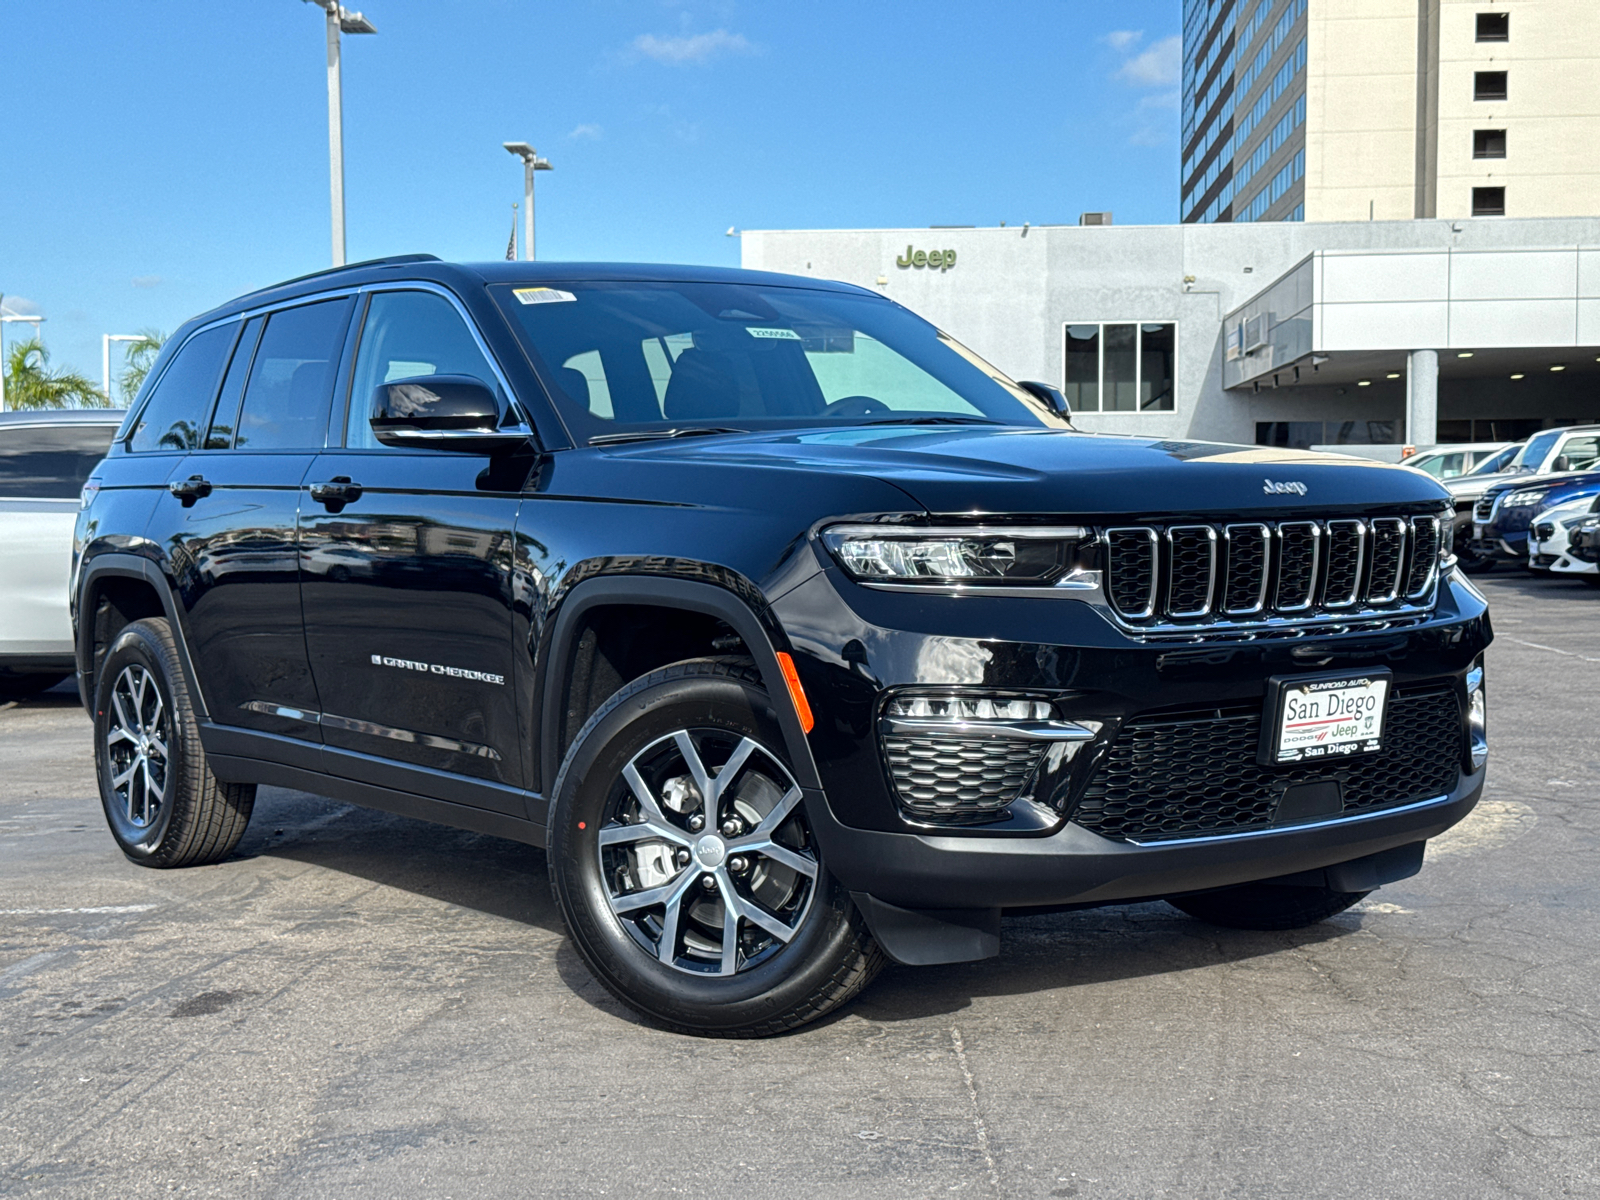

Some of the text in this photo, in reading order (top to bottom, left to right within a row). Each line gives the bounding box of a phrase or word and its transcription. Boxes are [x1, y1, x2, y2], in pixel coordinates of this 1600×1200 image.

[896, 245, 957, 270] Jeep
[1262, 478, 1308, 496] Jeep
[383, 657, 505, 685] GRAND CHEROKEE
[1309, 678, 1369, 691] SUNROAD AUTO
[1287, 691, 1375, 721] San Diego
[1331, 724, 1358, 737] Jeep
[1304, 747, 1325, 757] San
[1327, 742, 1358, 755] Diego
[699, 845, 721, 855] Jeep
